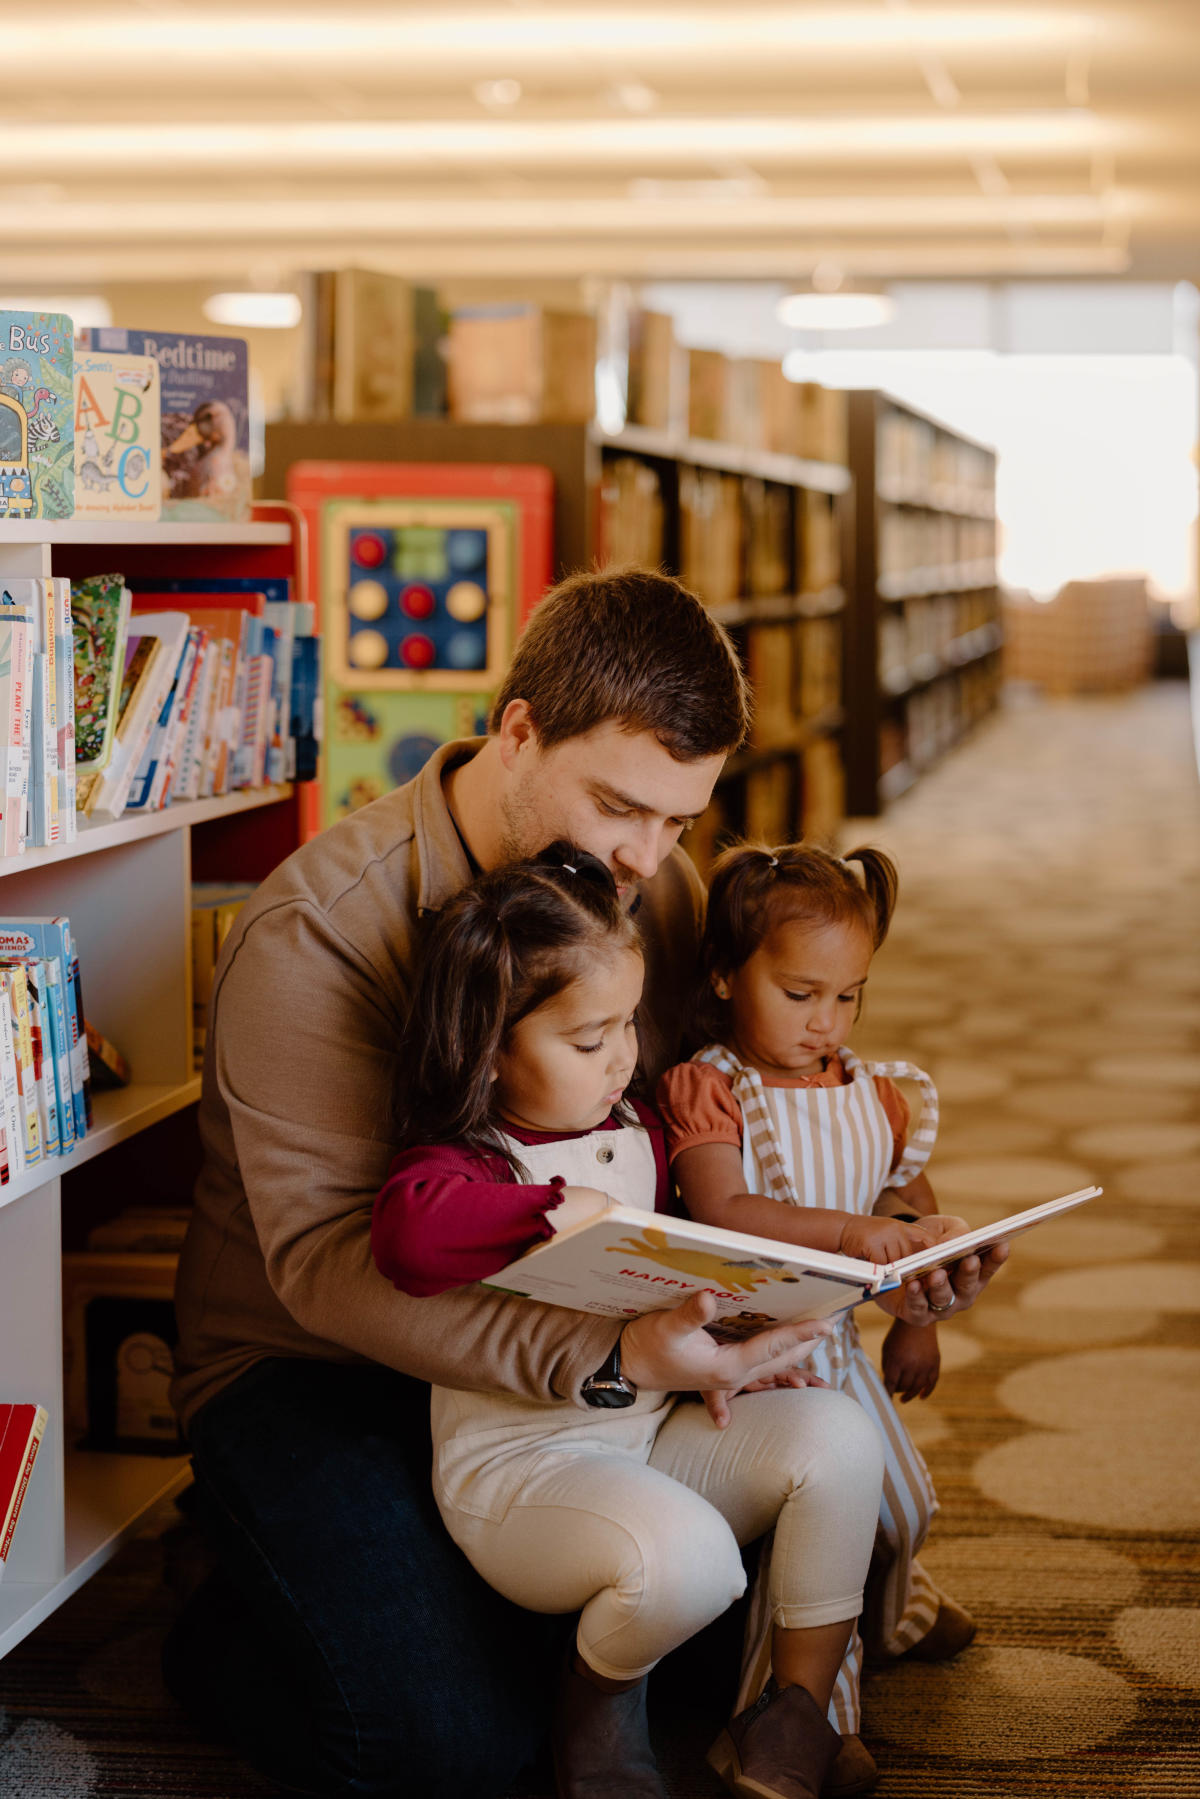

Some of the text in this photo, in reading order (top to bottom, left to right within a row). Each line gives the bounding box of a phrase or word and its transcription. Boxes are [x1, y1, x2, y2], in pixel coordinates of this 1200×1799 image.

[9, 325, 50, 354] Bus
[144, 338, 236, 372] Bedtime
[14, 681, 22, 712] PLANT
[13, 719, 21, 737] THE
[618, 1268, 695, 1289] HAPPY
[12, 1476, 28, 1518] Dinosaurs
